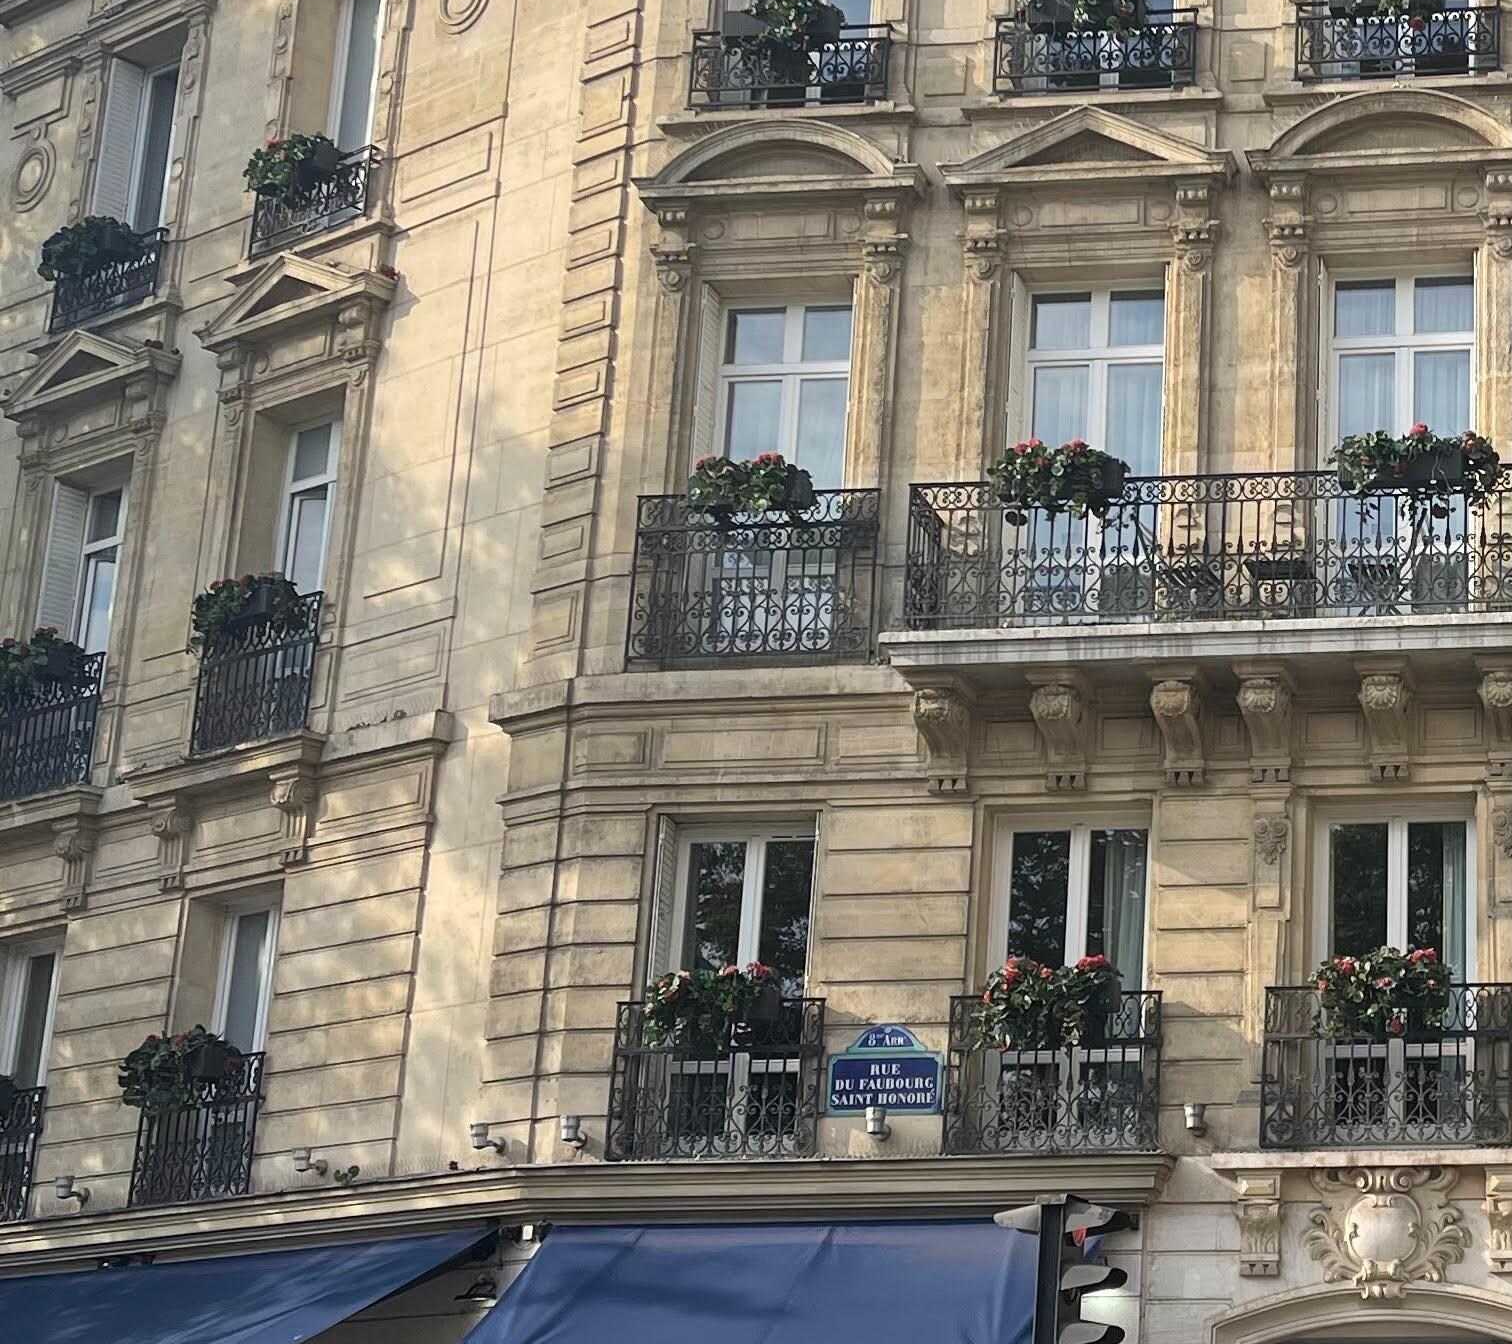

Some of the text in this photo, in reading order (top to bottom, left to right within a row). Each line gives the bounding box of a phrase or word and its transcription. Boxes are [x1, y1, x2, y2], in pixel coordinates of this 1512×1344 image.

[870, 1063, 900, 1076] RUE
[835, 1077, 934, 1091] DU FAUBOURG
[830, 1088, 936, 1106] SAINT HONORÉ
